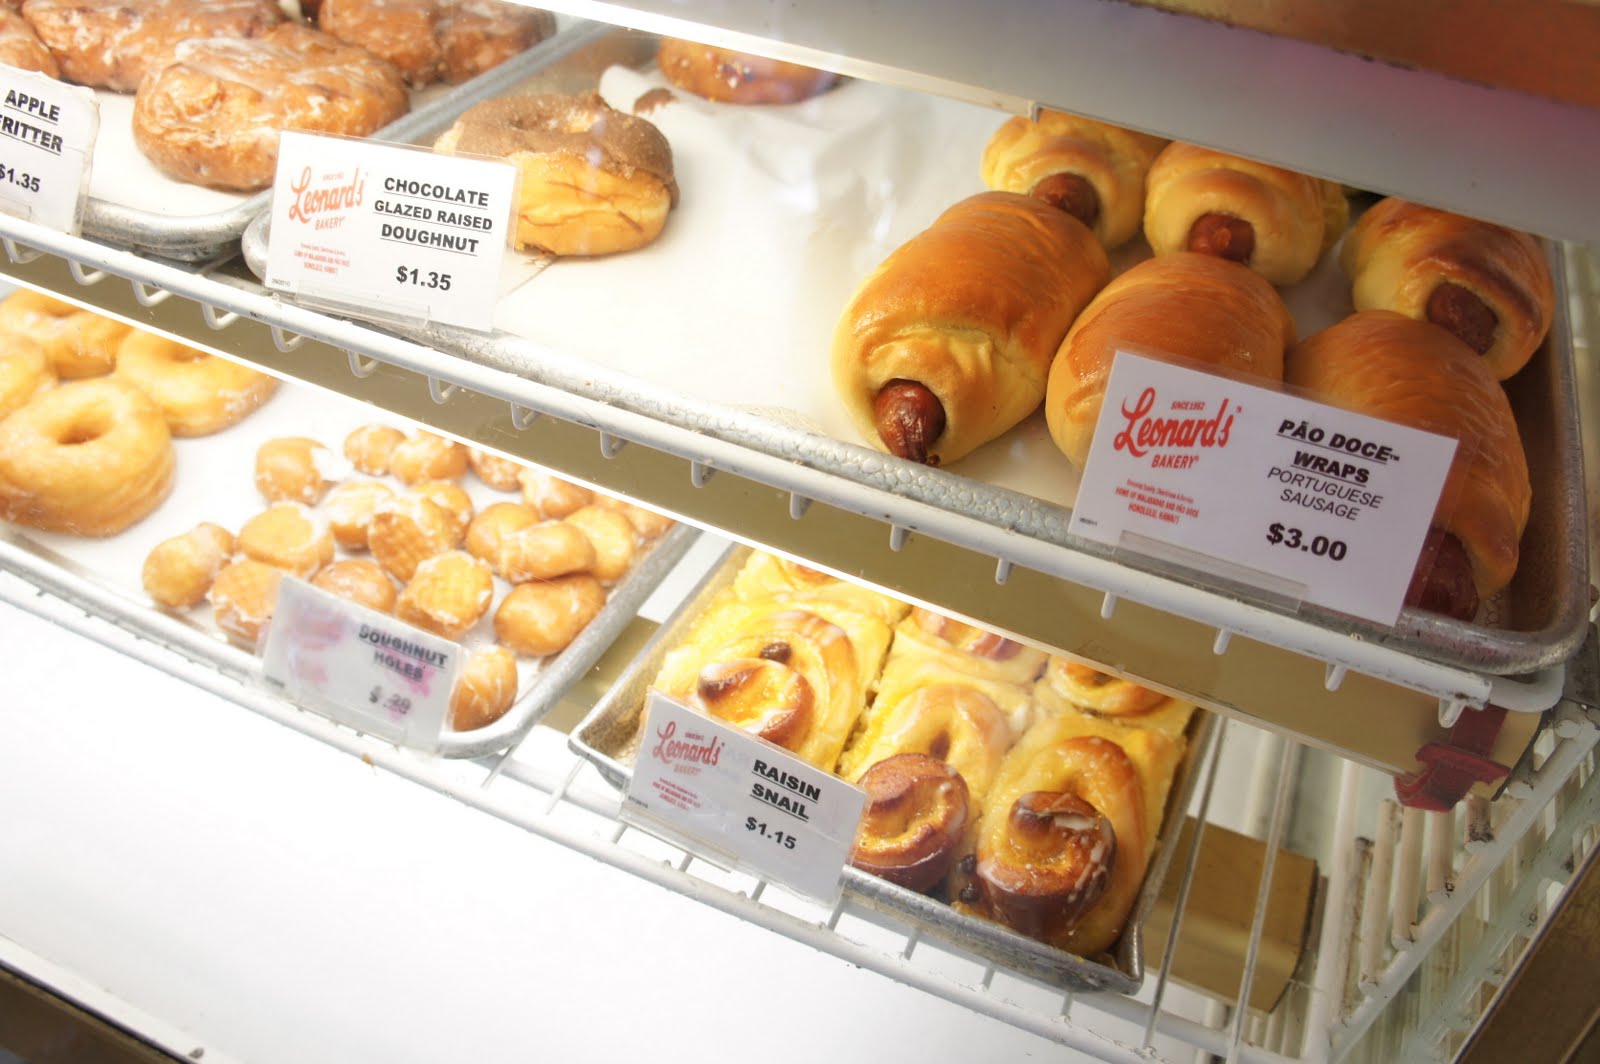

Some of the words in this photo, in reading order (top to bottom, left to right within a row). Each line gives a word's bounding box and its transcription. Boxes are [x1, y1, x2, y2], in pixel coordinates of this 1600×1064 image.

[5, 89, 60, 122] APPLE
[0, 115, 63, 152] RITTER
[384, 177, 489, 207] CHOCOLATE
[374, 200, 432, 220] GLAZED
[437, 210, 492, 230] RAISED
[381, 223, 479, 253] DOUGHNUT
[396, 265, 451, 291] $1.35
[1278, 419, 1325, 443] PÃO
[1293, 451, 1370, 483] WRAPS
[1267, 467, 1384, 509] PORTUGUESE
[1280, 488, 1360, 521] SAUSAGE
[1266, 522, 1347, 561] $3.00
[359, 624, 448, 666] DOUGHNUT
[374, 649, 423, 682] HOLES
[753, 759, 821, 801] RAISIN
[752, 782, 809, 819] SNAIL
[745, 816, 797, 850] $1.15
